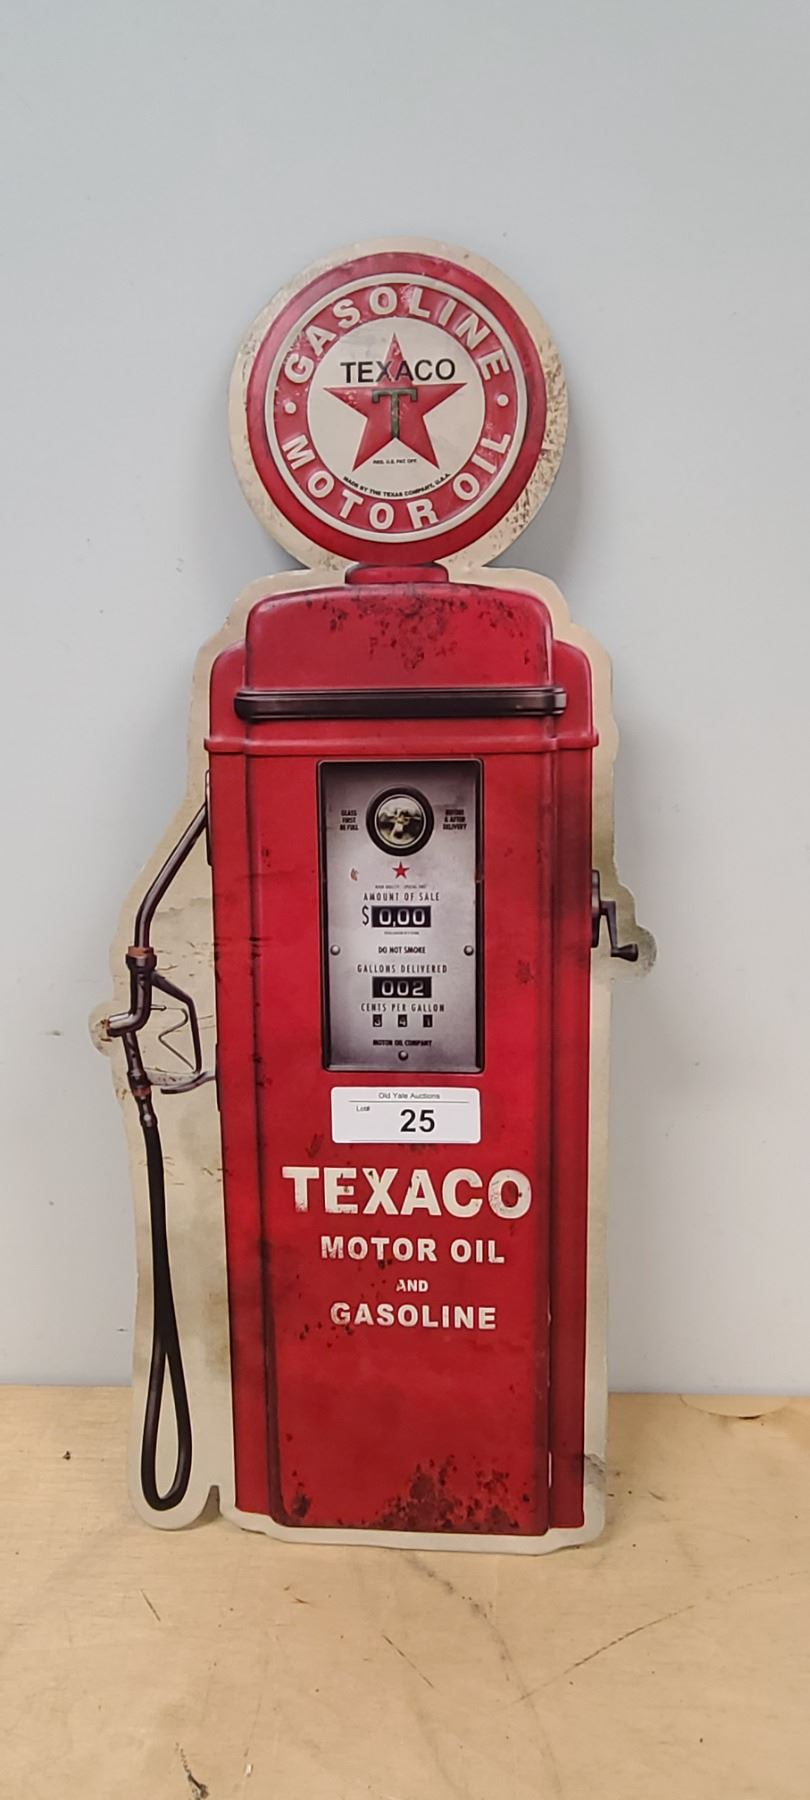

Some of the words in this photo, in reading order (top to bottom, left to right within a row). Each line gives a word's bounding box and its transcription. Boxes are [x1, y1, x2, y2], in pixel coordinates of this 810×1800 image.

[284, 286, 509, 383] GASOLINE
[340, 358, 456, 383] TEXACO
[282, 434, 439, 530] MOTOR
[452, 433, 510, 500] OIL
[359, 485, 369, 493] BY
[370, 488, 382, 496] THE
[363, 892, 399, 901] AMOUNT
[404, 892, 415, 901] OF
[419, 892, 440, 901] SALE
[361, 904, 369, 926] $
[378, 946, 387, 954] DO
[389, 946, 402, 954] NOT
[404, 946, 426, 954] SMOKE
[357, 964, 396, 973] GALLONS
[400, 964, 448, 973] DELIVERED
[381, 980, 424, 996] 002
[360, 1003, 387, 1012] CENTS
[391, 1003, 406, 1012] PER
[411, 1003, 445, 1012] GALLON
[410, 1092, 441, 1100] Auctions
[400, 1109, 435, 1133] 25
[282, 1166, 532, 1219] TEXACO
[320, 1236, 437, 1262] MOTOR
[450, 1239, 505, 1263] OIL
[396, 1279, 429, 1292] AND
[330, 1302, 496, 1330] GASOLINE
